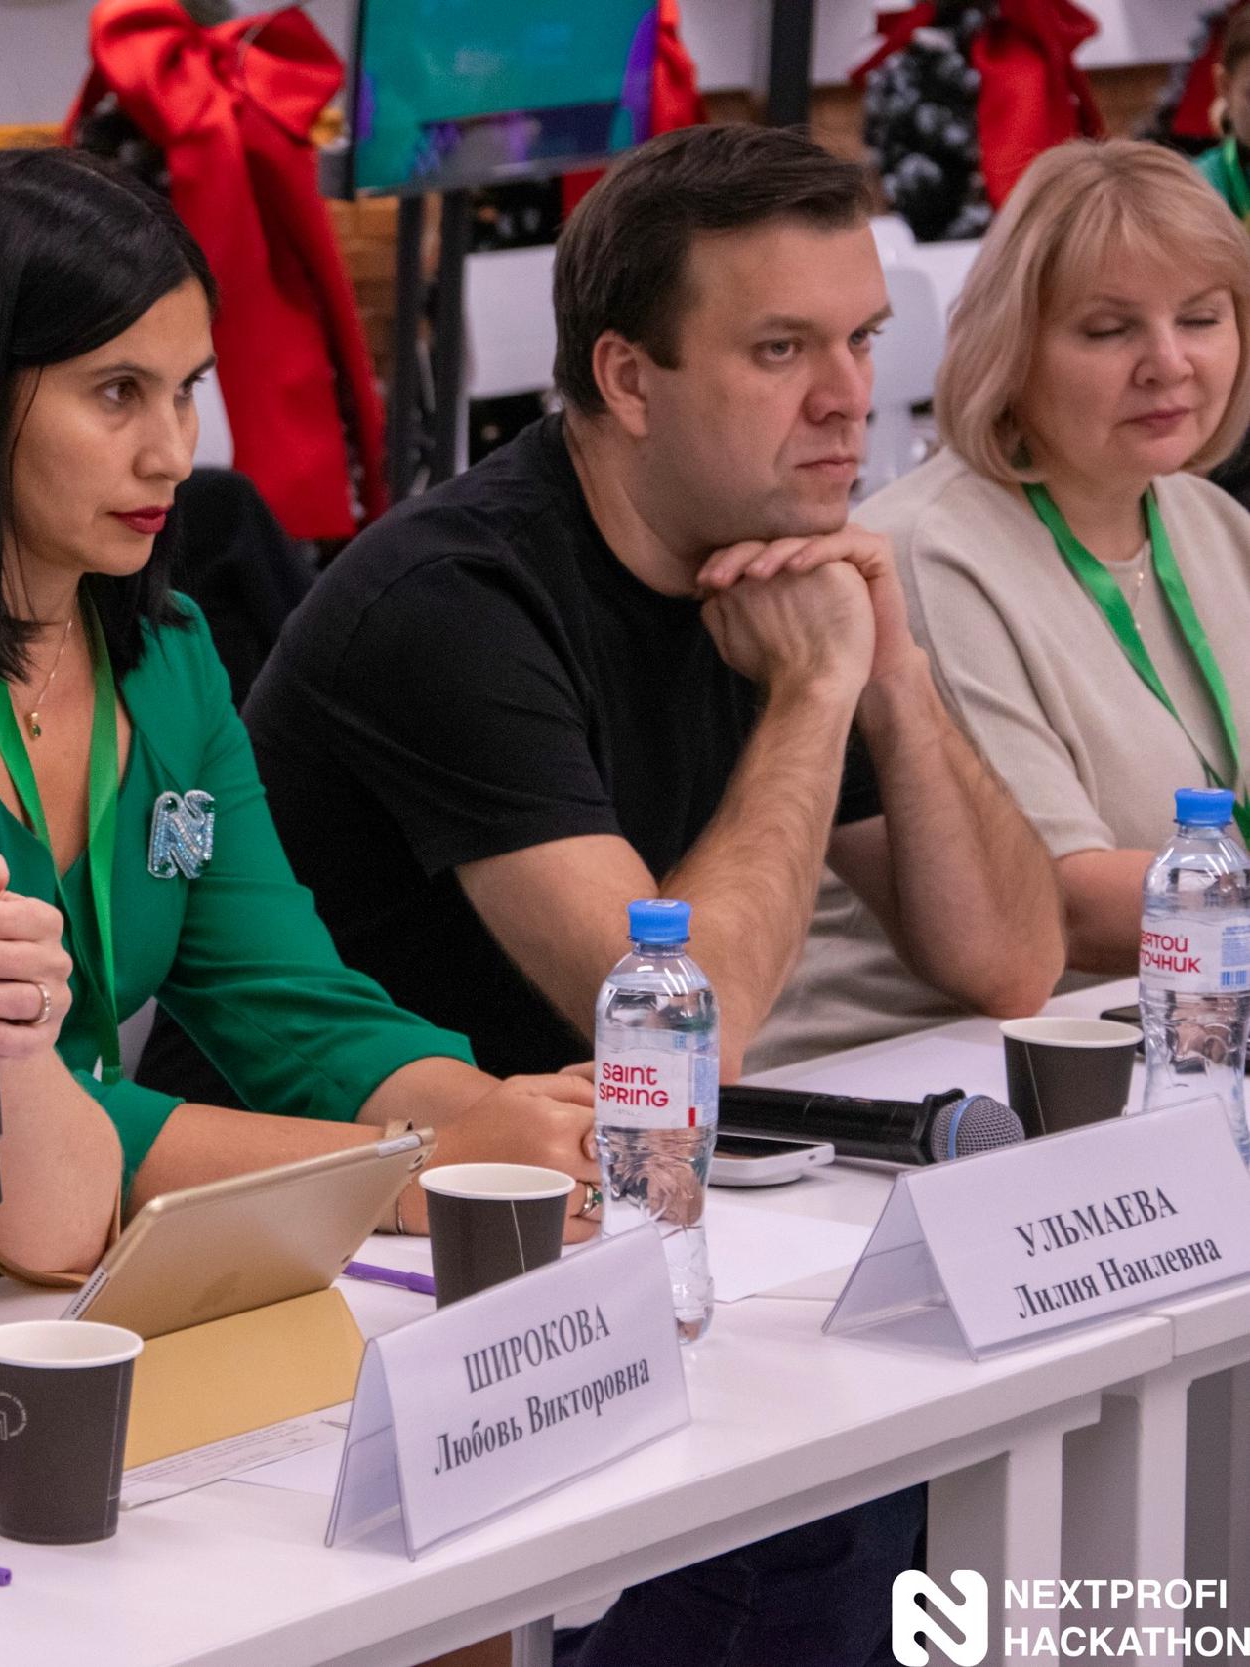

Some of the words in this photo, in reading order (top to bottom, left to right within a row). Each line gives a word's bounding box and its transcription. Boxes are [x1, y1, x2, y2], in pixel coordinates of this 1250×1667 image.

[1141, 930, 1189, 953] ВЯТОЙ
[1141, 949, 1202, 974] ТОЧНИК
[599, 1082, 669, 1107] SPRING
[1013, 1186, 1180, 1258] УЛЬМАЕВА
[1013, 1283, 1102, 1319] Лилия
[1096, 1238, 1223, 1293] Наилевна
[463, 1303, 611, 1394] ШИРОКОВА
[434, 1419, 523, 1476] Любовь
[525, 1358, 650, 1434] Викторовна
